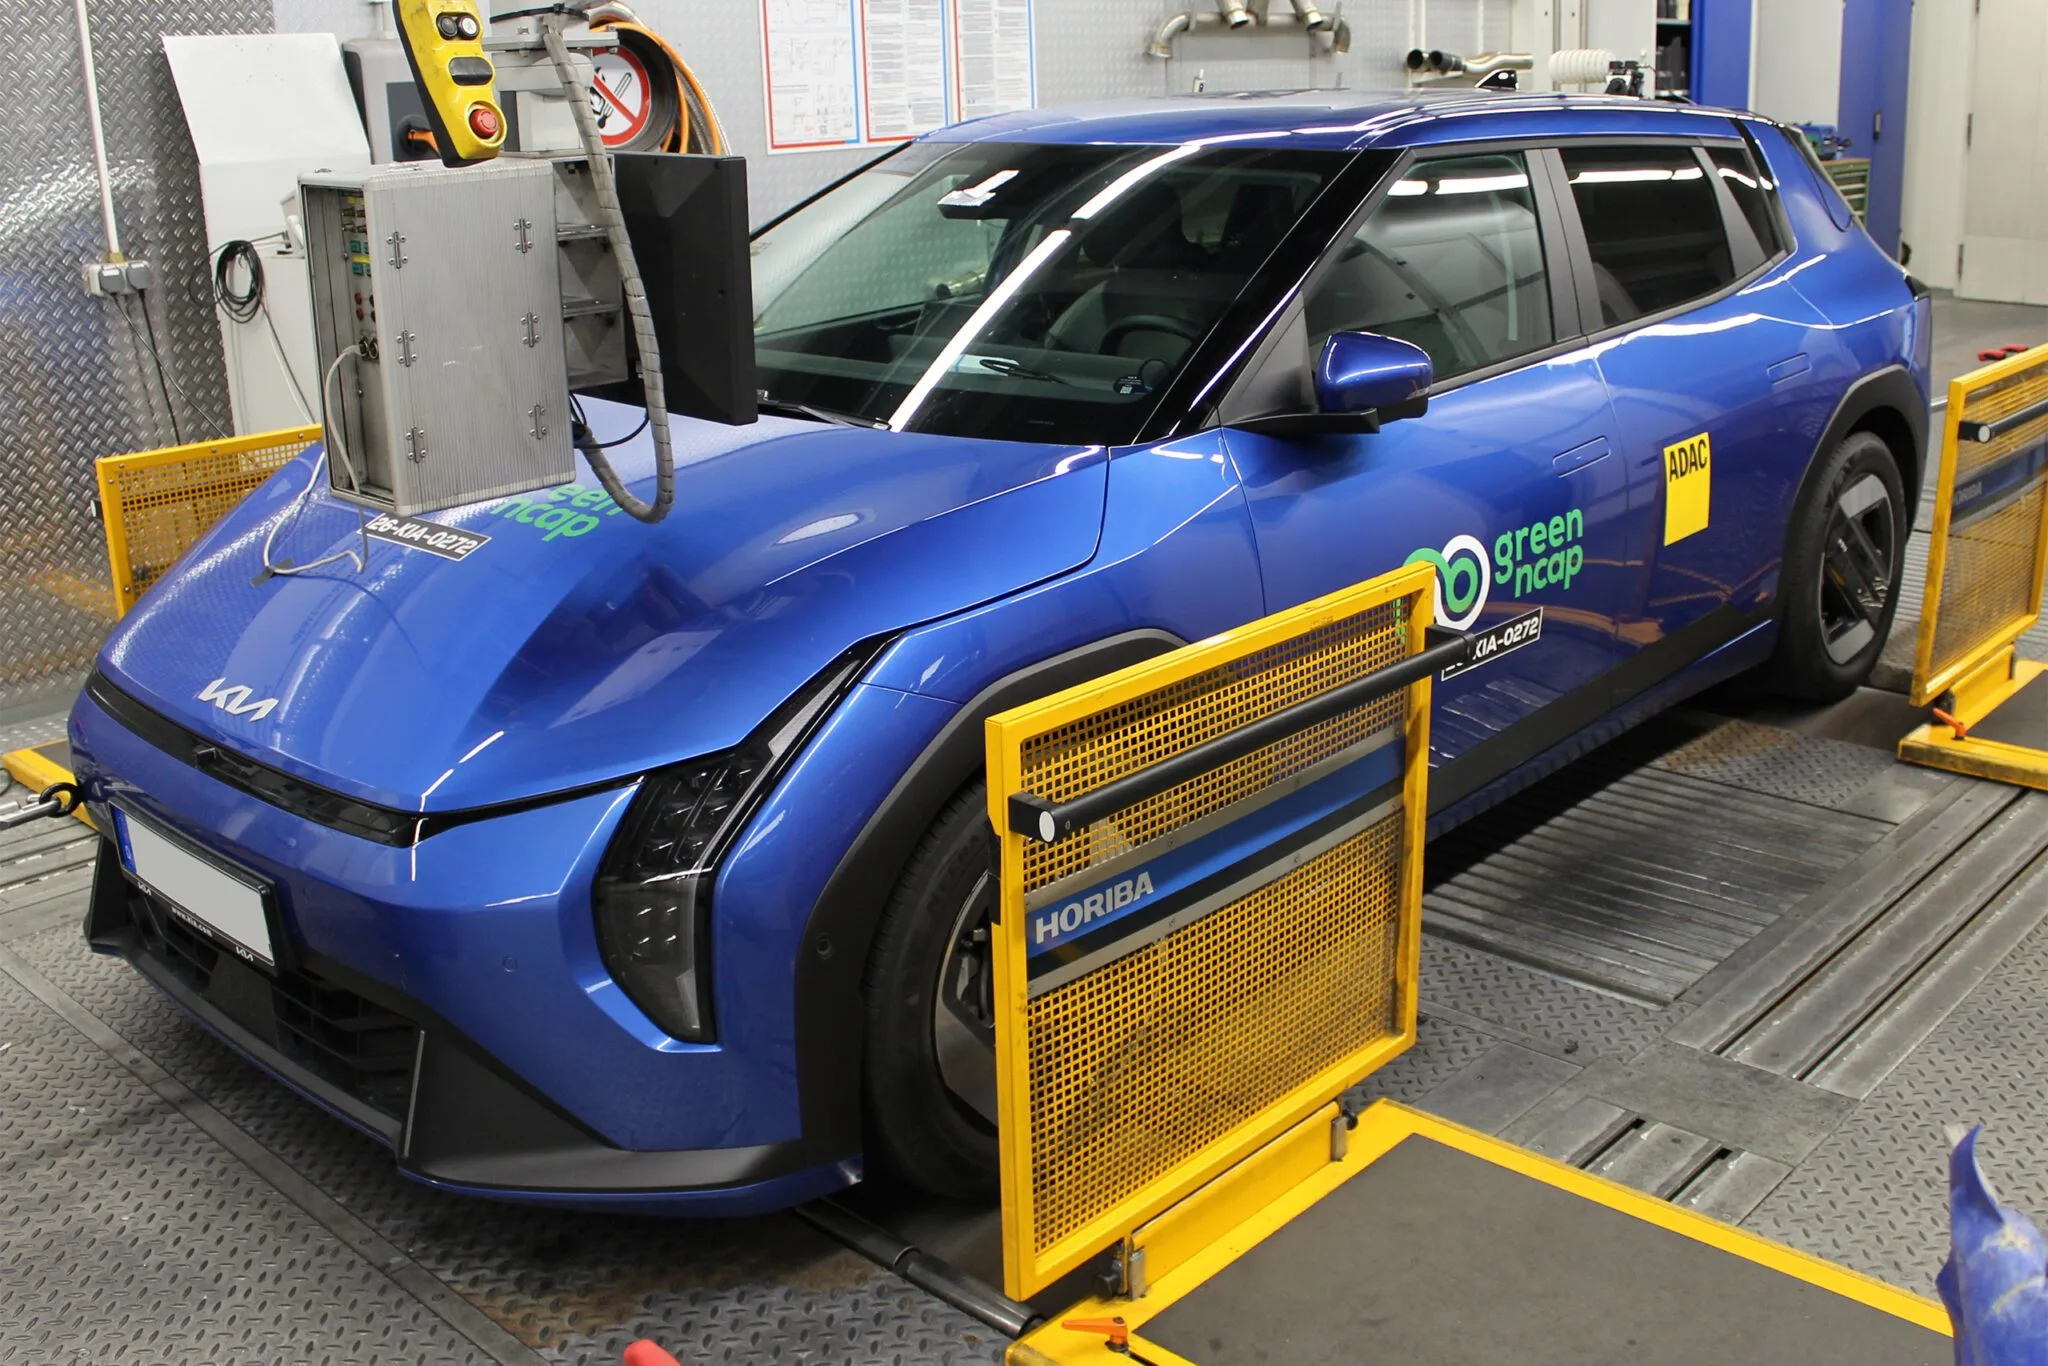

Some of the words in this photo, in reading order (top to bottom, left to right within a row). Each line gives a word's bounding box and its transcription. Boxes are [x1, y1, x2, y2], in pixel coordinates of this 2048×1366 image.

[1669, 439, 1708, 482] ADAC
[490, 496, 600, 542] ncap
[1494, 508, 1584, 585] green
[1514, 544, 1584, 598] ncap
[198, 677, 279, 722] KIA
[1035, 871, 1154, 944] HORIBA
